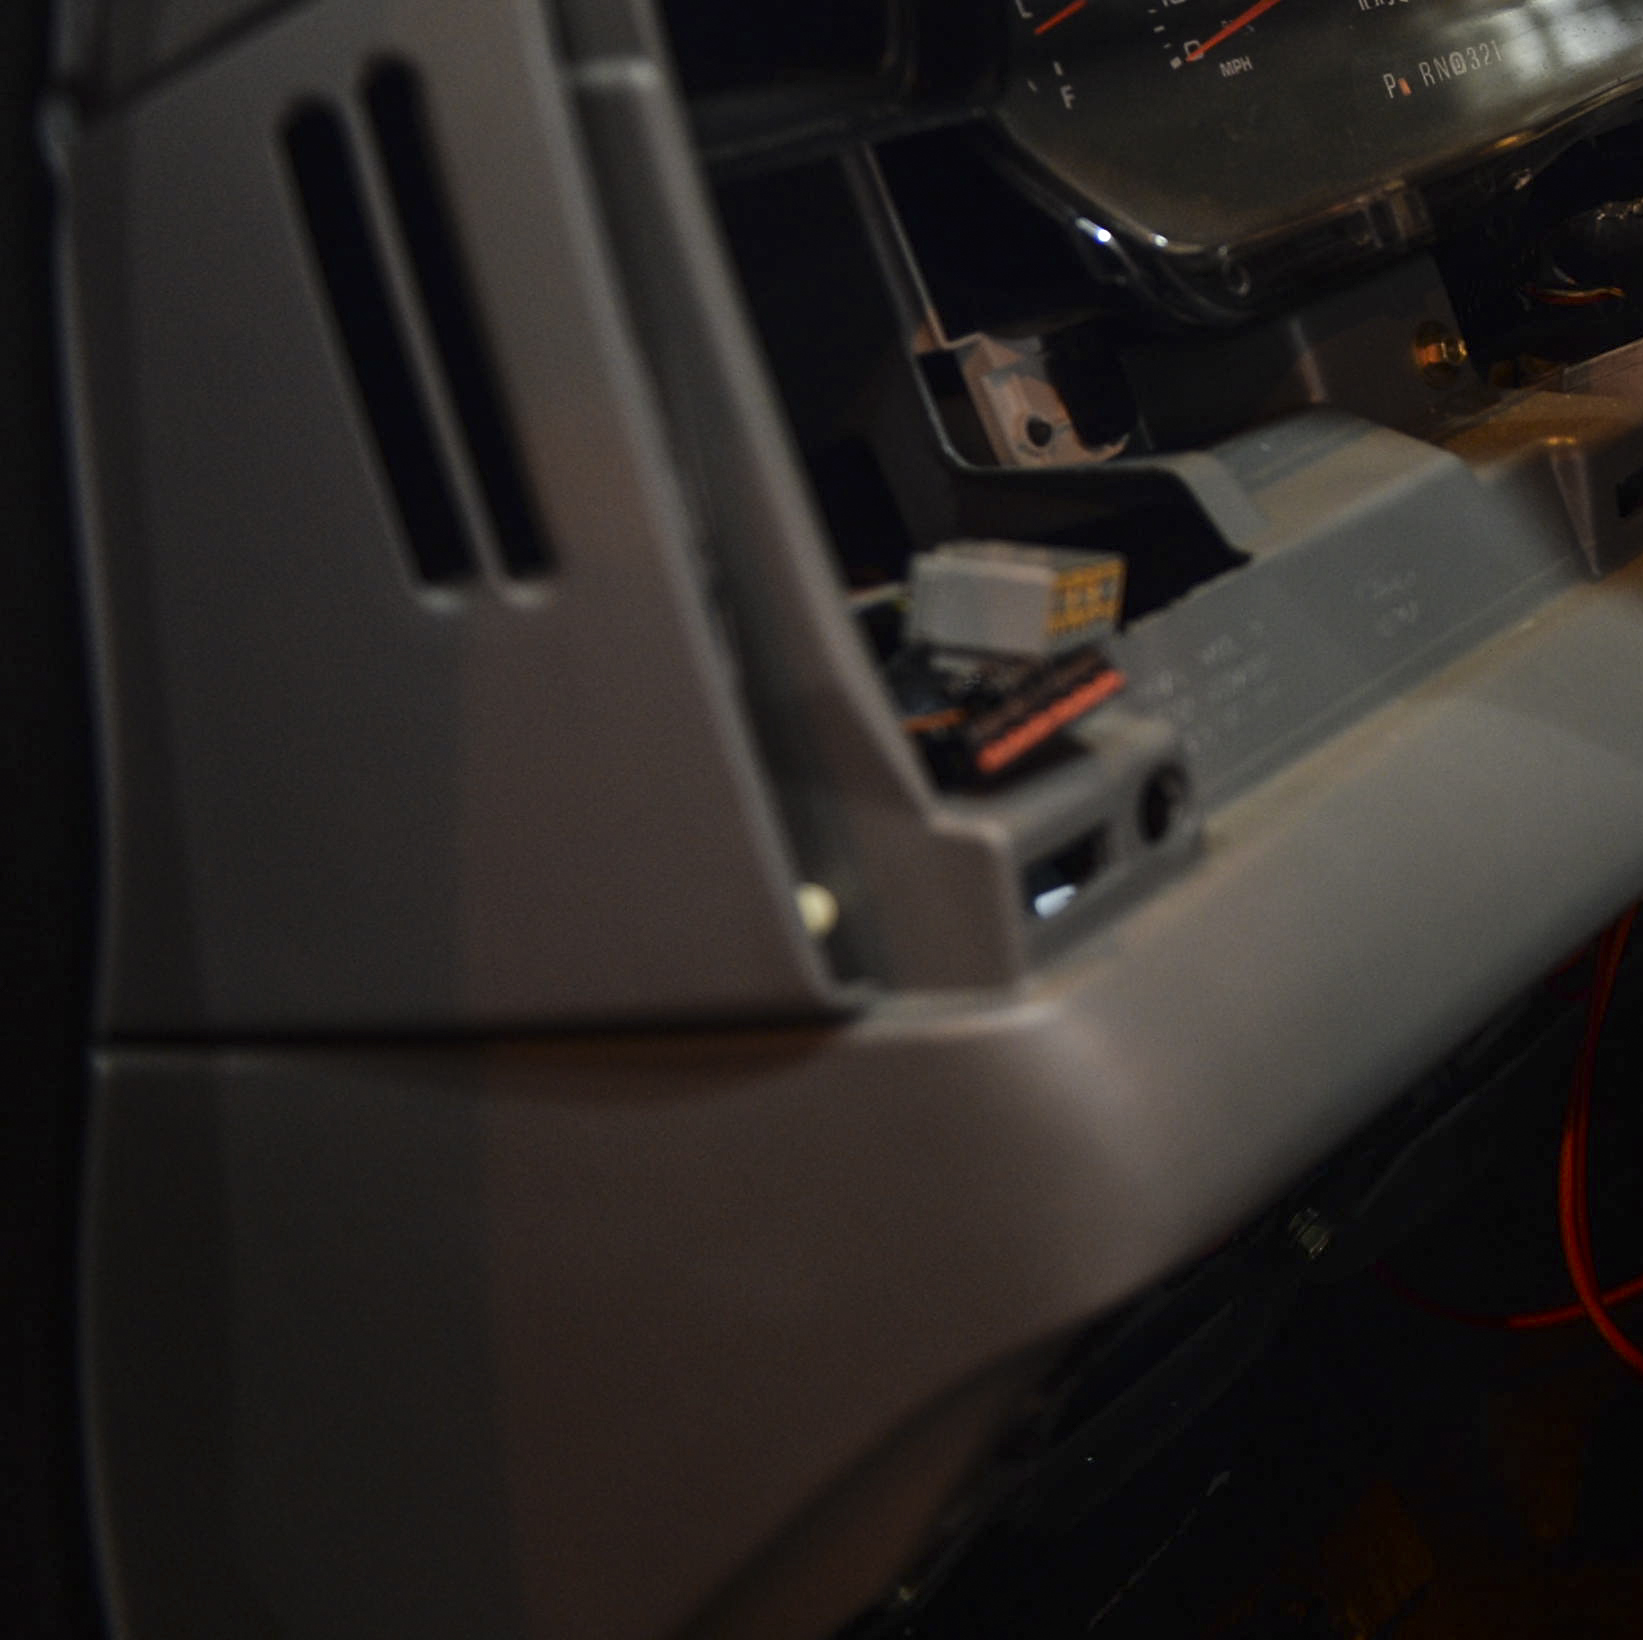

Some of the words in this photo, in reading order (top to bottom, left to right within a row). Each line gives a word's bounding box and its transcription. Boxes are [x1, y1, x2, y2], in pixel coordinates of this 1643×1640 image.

[1219, 55, 1254, 78] MPH
[1060, 83, 1077, 110] F
[1383, 73, 1397, 99] P
